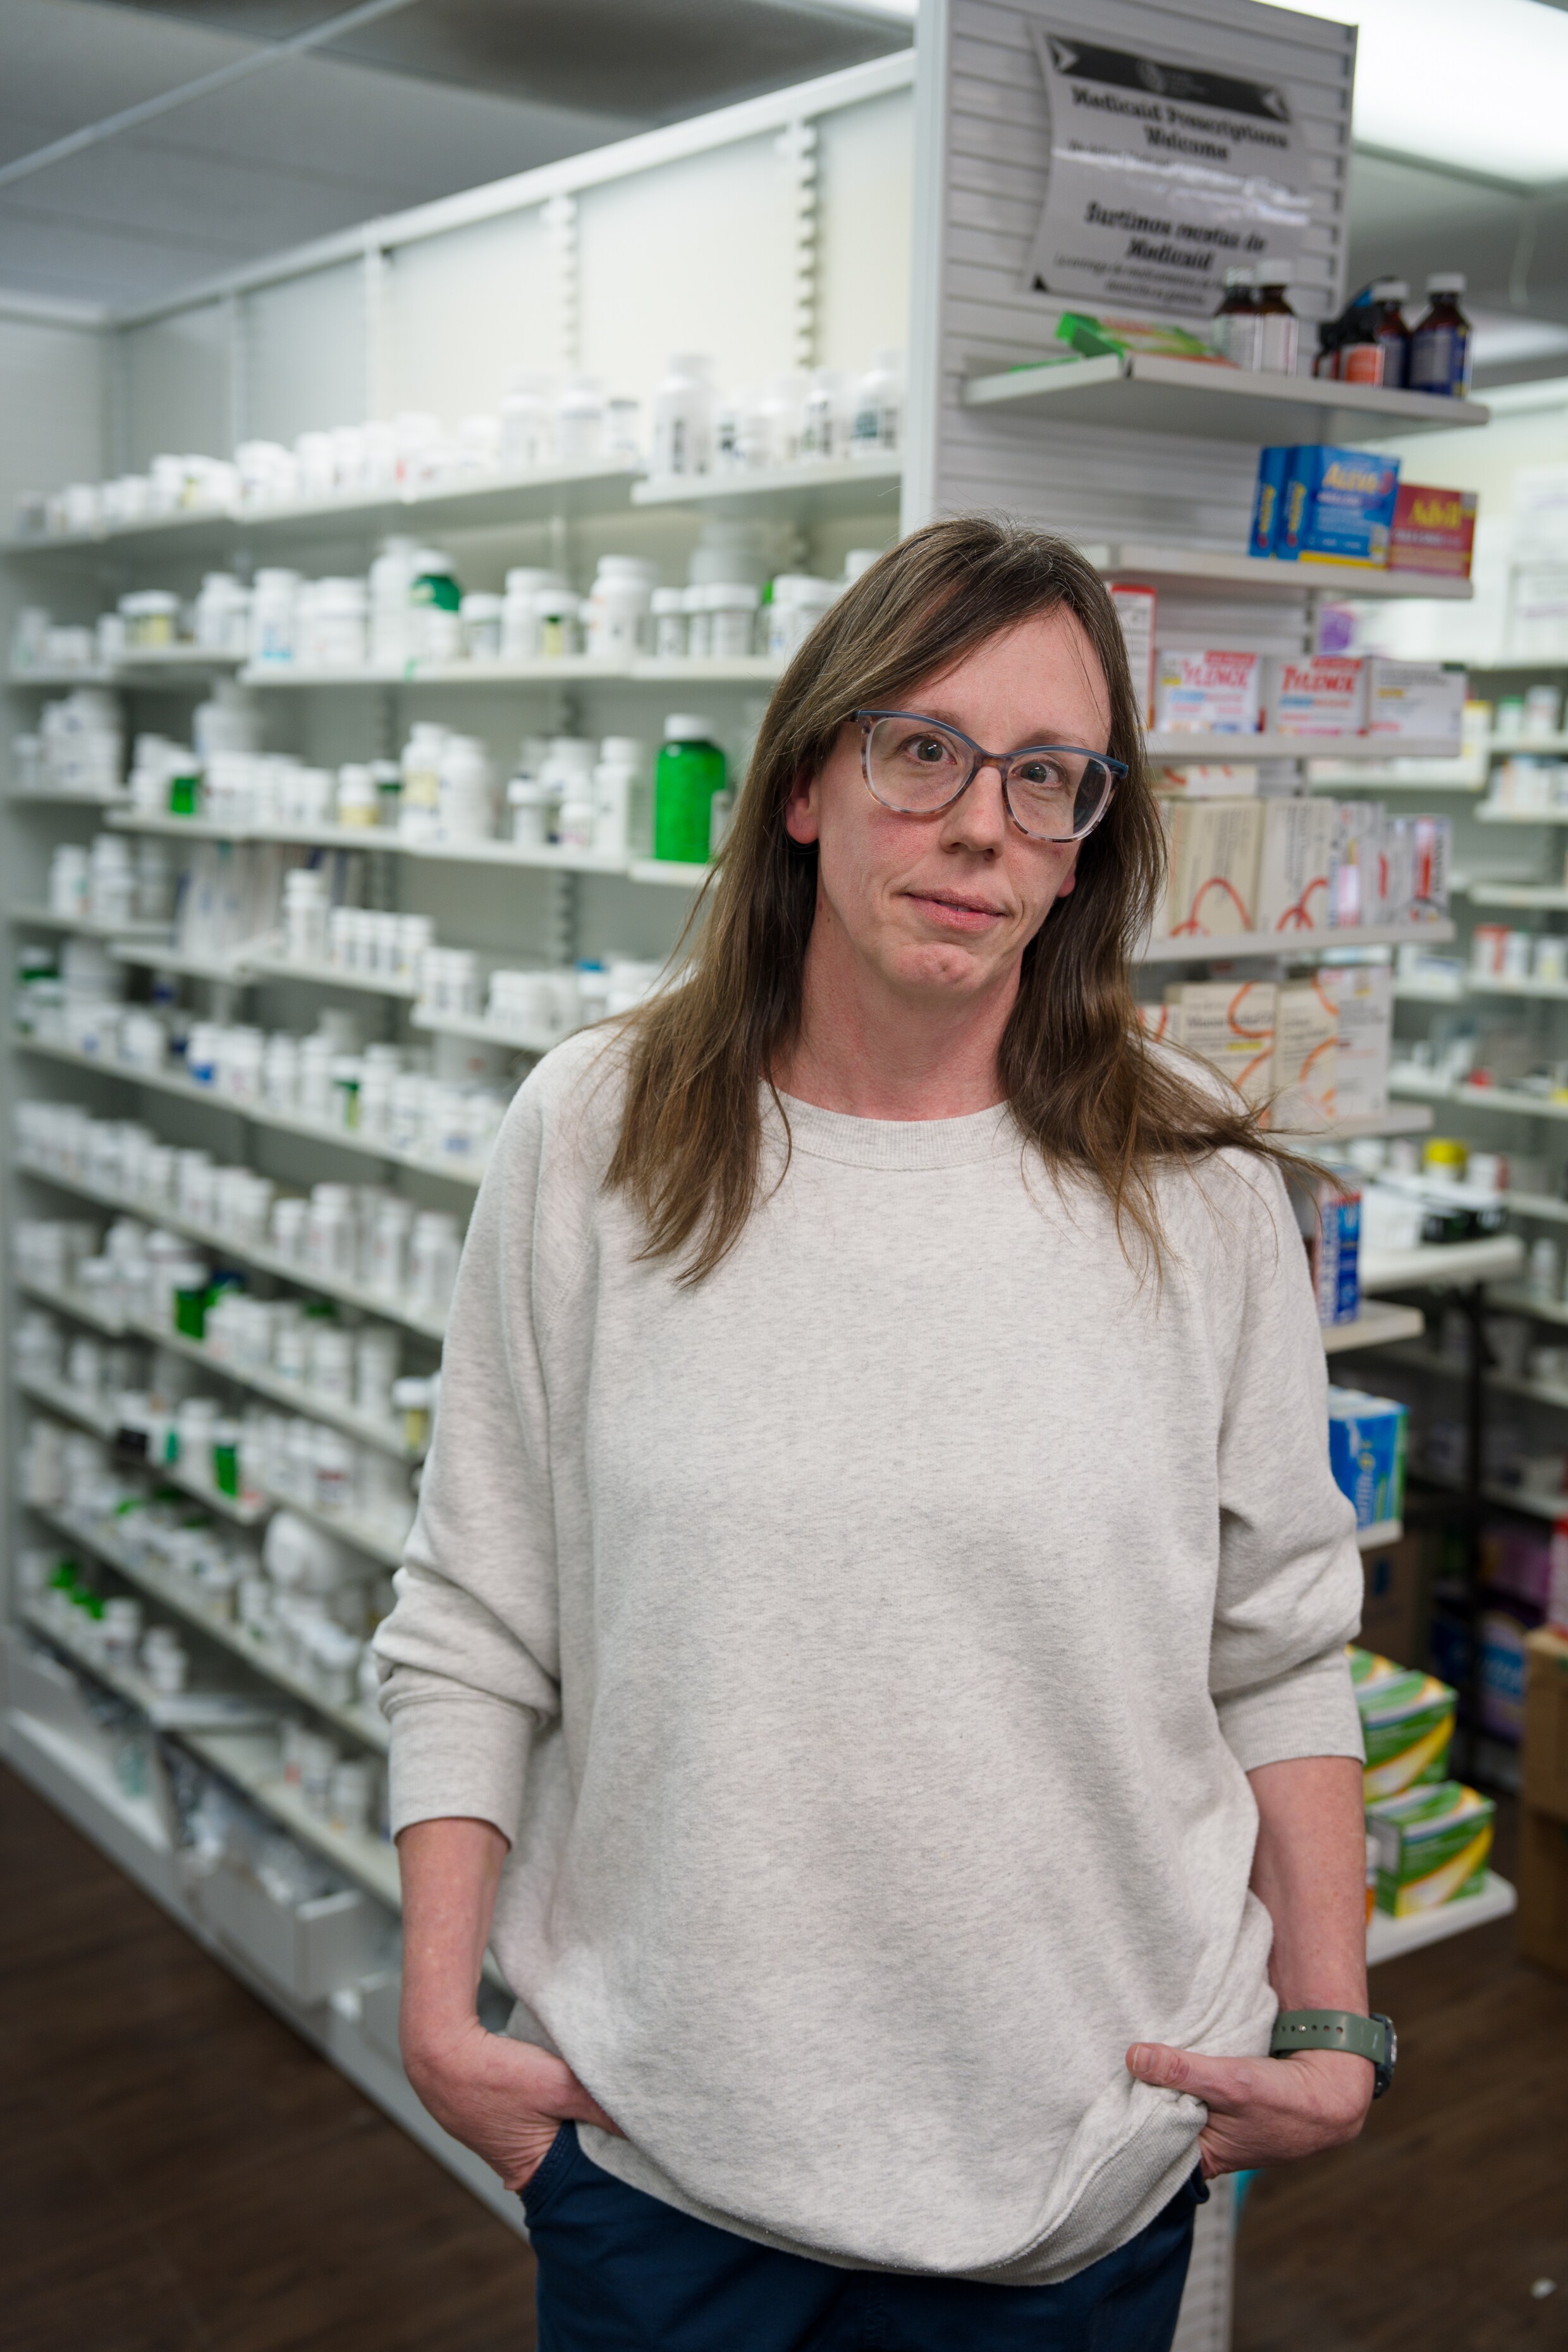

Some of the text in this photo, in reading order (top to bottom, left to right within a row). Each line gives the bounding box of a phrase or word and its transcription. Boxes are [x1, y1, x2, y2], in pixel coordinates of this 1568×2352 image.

[1072, 87, 1289, 149] Medicaid Prescriptions
[1144, 126, 1228, 159] Welcome
[1085, 200, 1171, 235] Surtimos
[1244, 231, 1266, 253] de
[1127, 238, 1214, 271] Medicaid
[1281, 665, 1354, 694] TYLENOL
